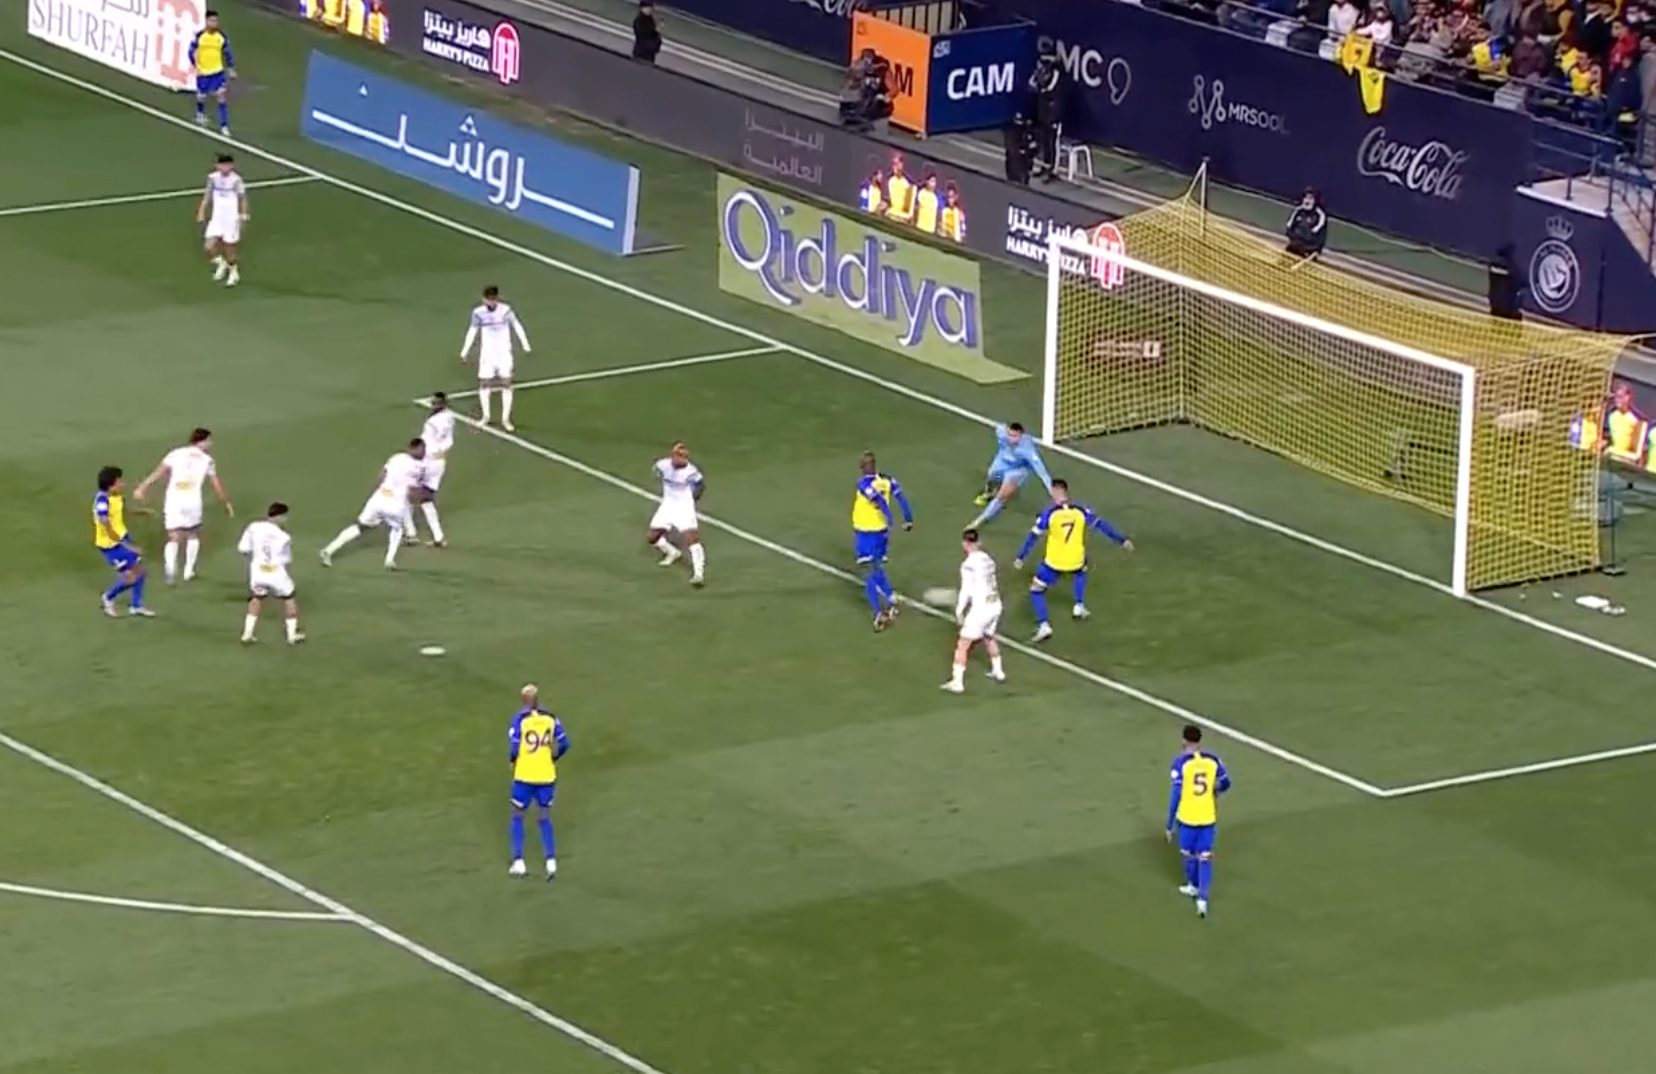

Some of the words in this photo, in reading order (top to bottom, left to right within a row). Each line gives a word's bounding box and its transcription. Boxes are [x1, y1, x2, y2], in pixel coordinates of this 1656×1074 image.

[32, 0, 149, 68] SHURFAH
[463, 50, 490, 72] PIZZA
[946, 62, 1015, 101] CAM
[1228, 102, 1291, 135] MRSOOL
[724, 189, 980, 349] Qiddiya
[1061, 518, 1076, 545] 7
[525, 727, 552, 754] 94
[1193, 771, 1208, 797] 5
